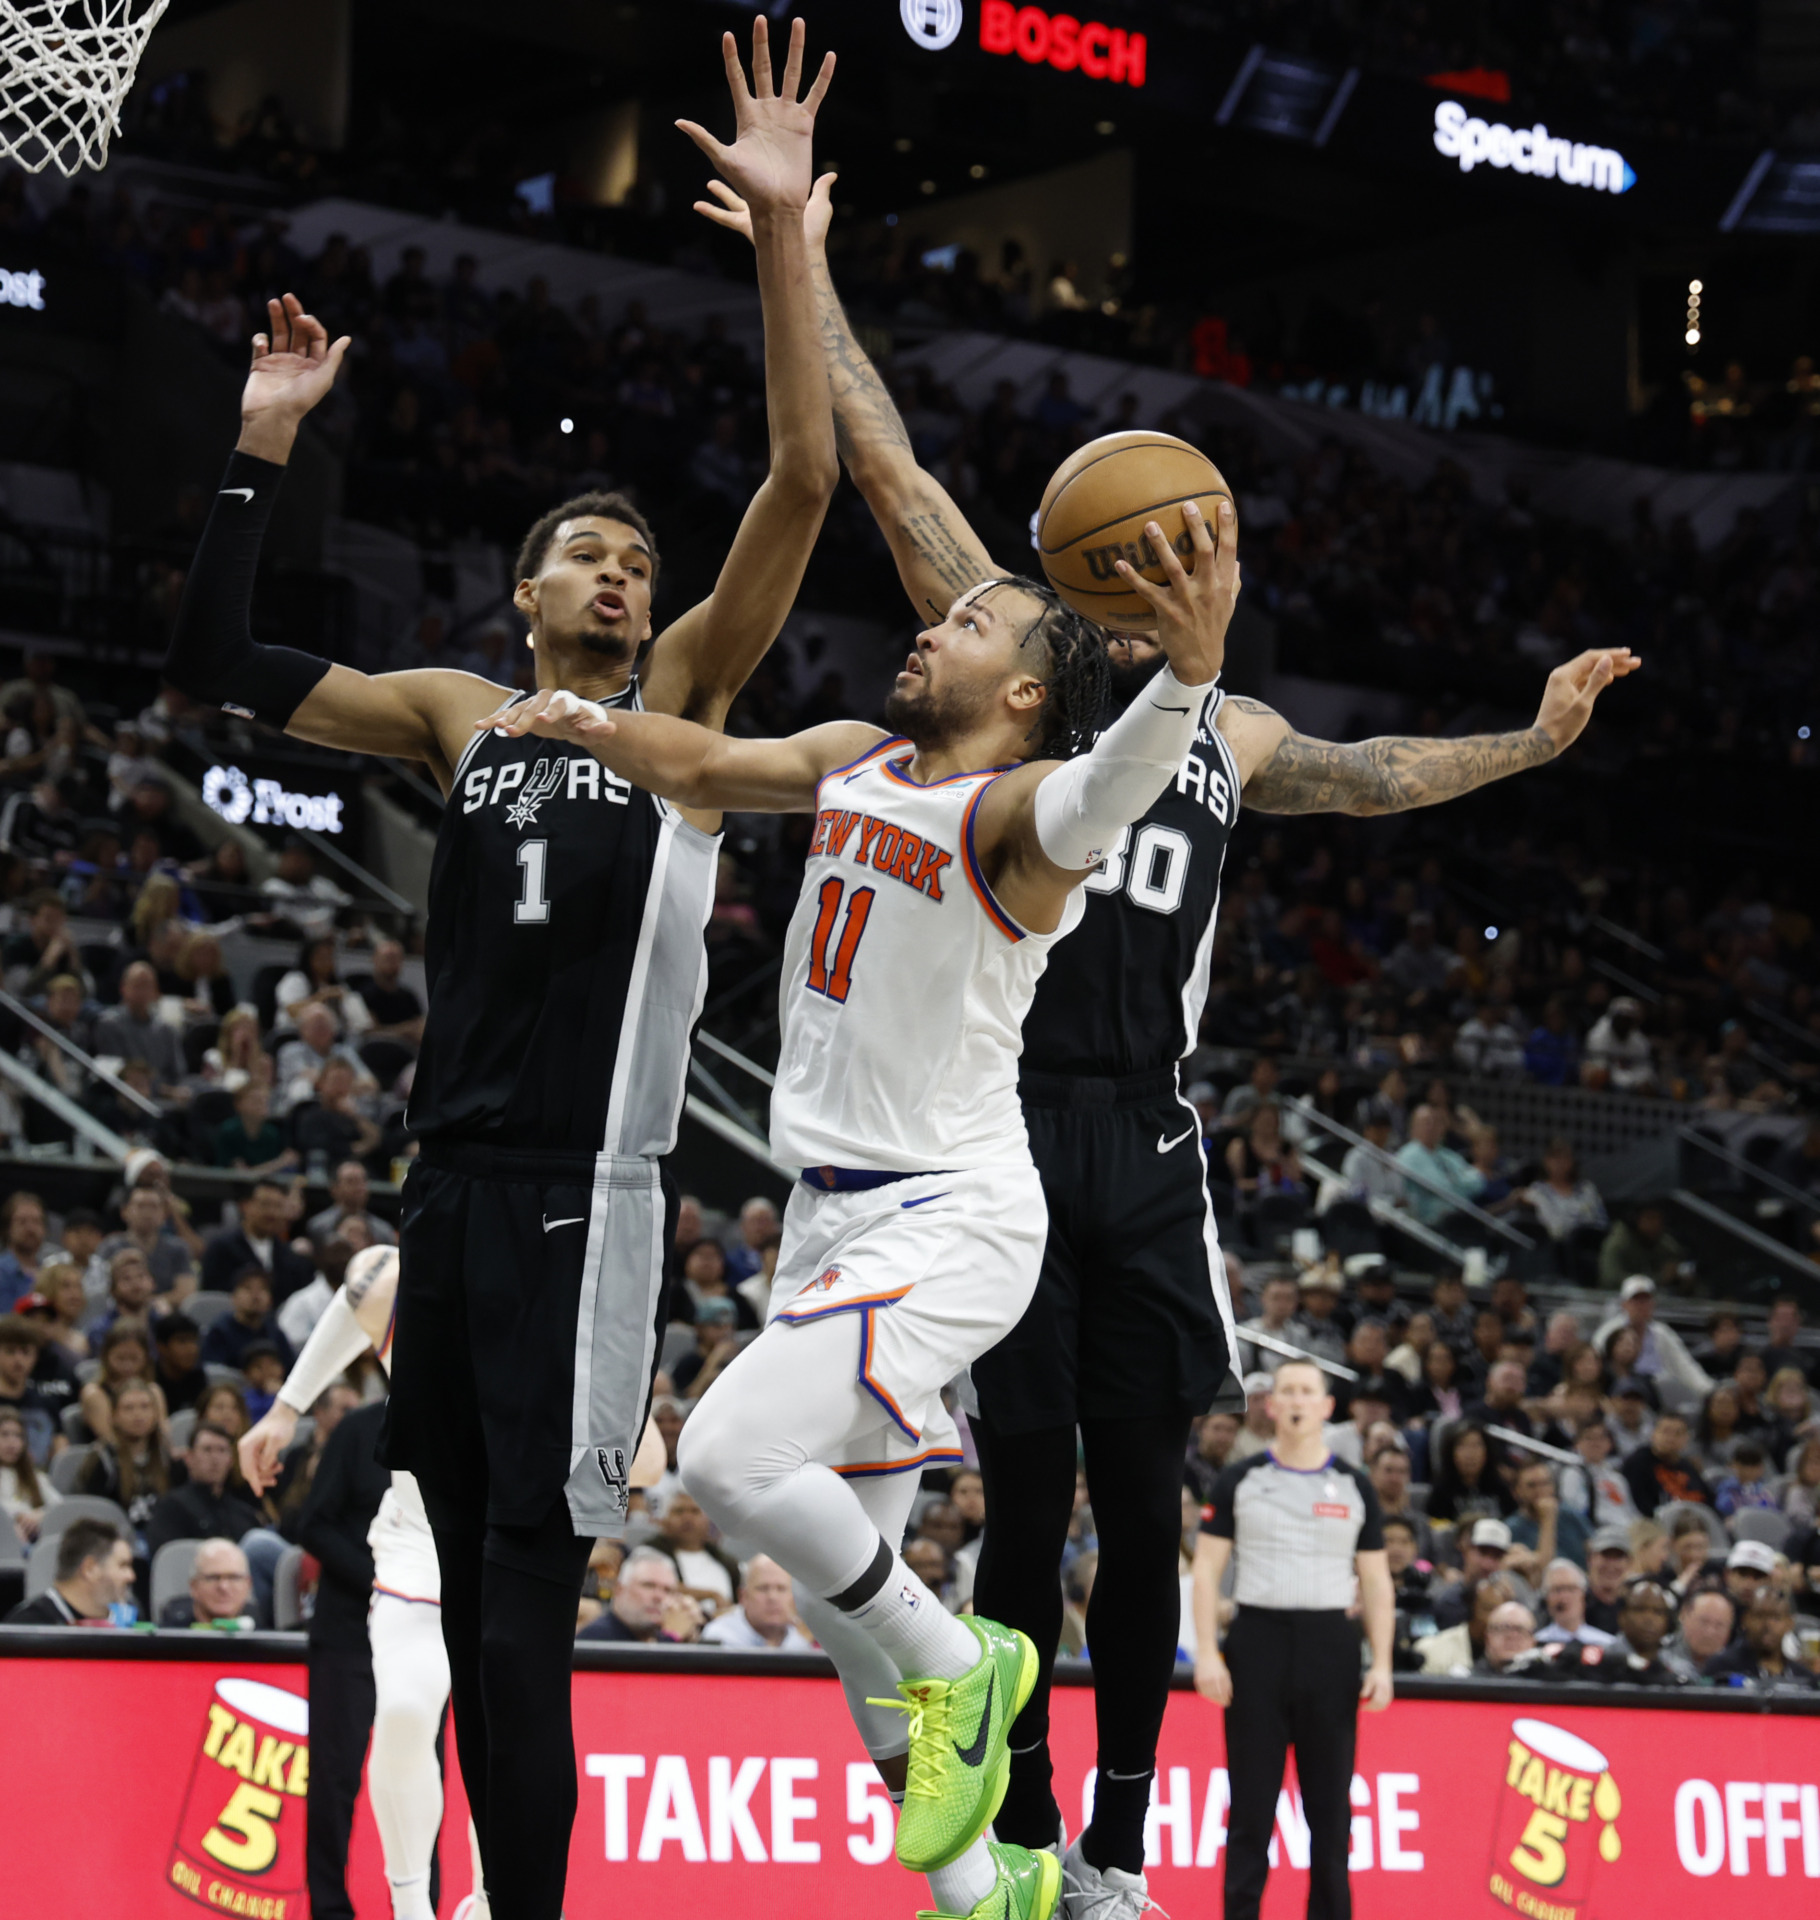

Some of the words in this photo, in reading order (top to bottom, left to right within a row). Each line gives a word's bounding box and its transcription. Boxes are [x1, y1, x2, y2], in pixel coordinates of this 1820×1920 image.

[978, 0, 1148, 88] BOSCH
[1433, 100, 1625, 194] Spectrum
[1082, 519, 1218, 581] Wilon
[252, 777, 345, 834] Frost
[463, 757, 633, 820] SPURS
[514, 838, 551, 924] 1
[807, 809, 861, 858] EW
[853, 815, 954, 905] YORK
[805, 875, 876, 1005] 11
[203, 1702, 309, 1797] TAKE
[1505, 1739, 1594, 1823] TAKE
[201, 1781, 283, 1877] 5
[585, 1753, 821, 1863] TAKE
[846, 1761, 895, 1866] 5
[1509, 1807, 1569, 1888] 5
[172, 1860, 201, 1897] OIL
[207, 1880, 287, 1920] CHANGE
